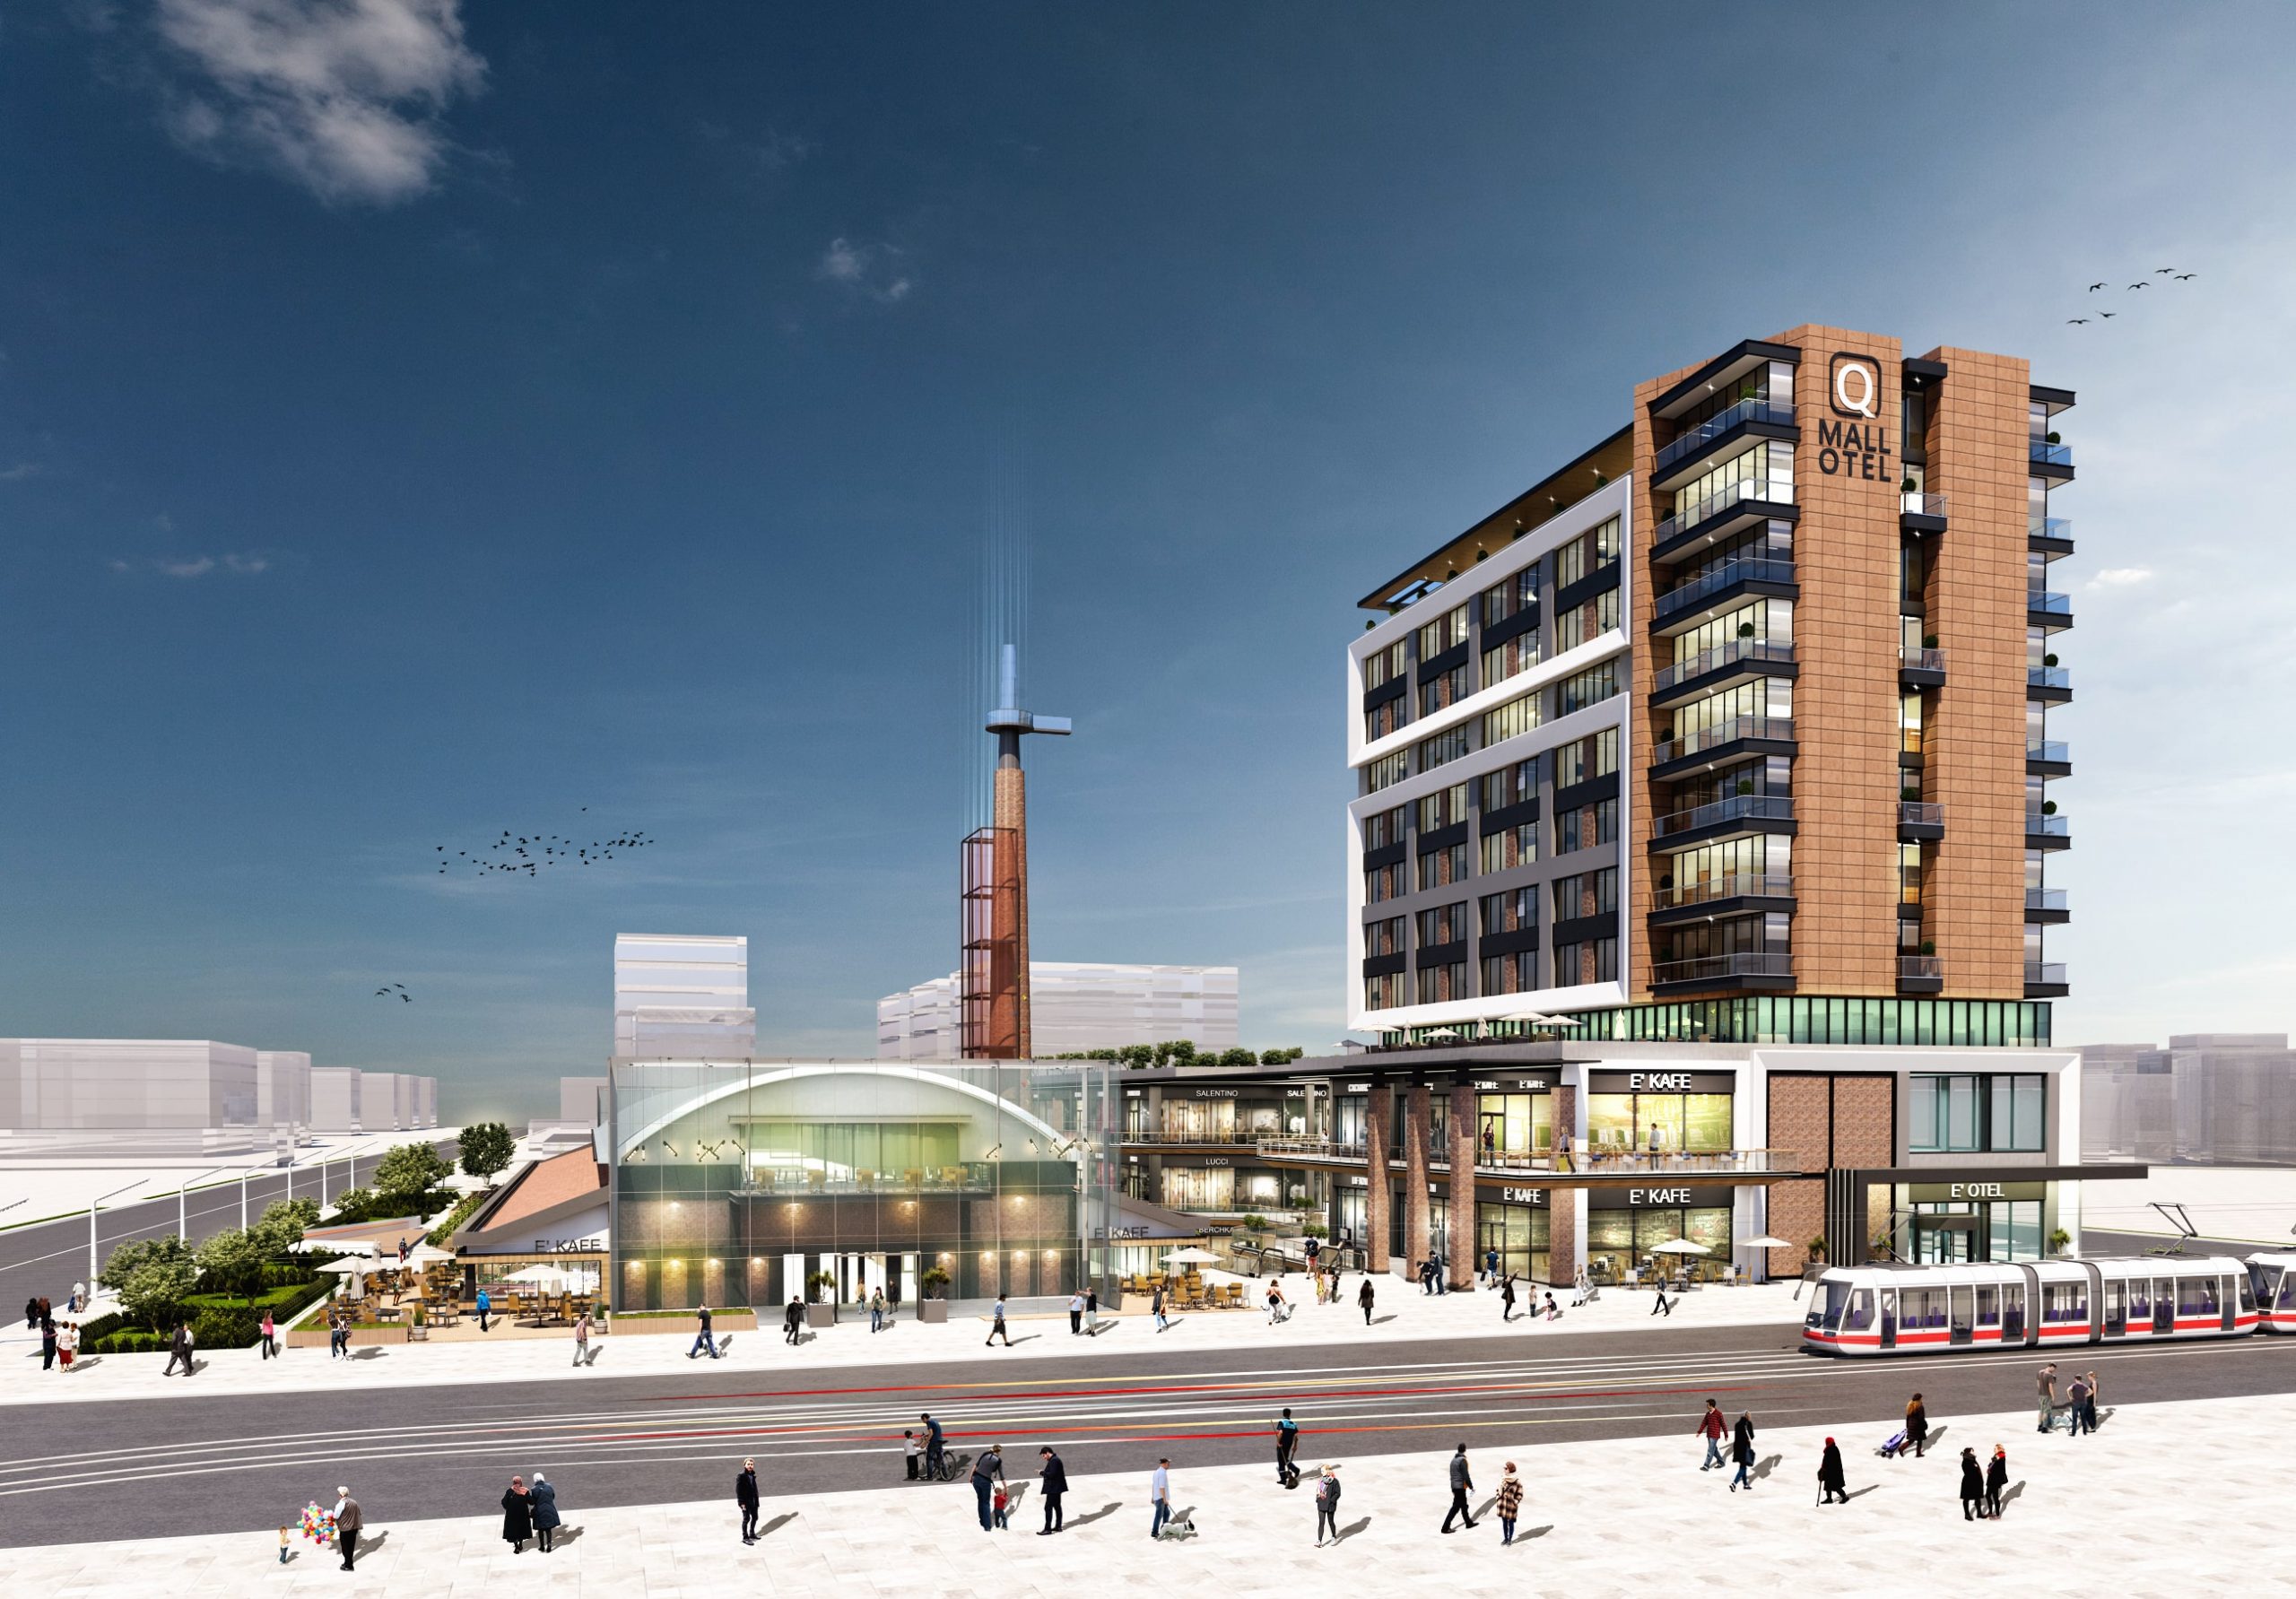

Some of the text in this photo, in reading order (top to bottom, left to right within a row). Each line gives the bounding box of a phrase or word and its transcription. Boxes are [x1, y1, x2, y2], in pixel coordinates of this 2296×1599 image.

[1837, 363, 1876, 419] Q
[1819, 419, 1891, 454] MALL
[1819, 448, 1892, 482] OTEL
[1648, 1073, 1692, 1089] KAFE
[1515, 1187, 1542, 1204] KAFE
[1648, 1188, 1691, 1204] KAFE
[1967, 1183, 2005, 1197] OTEL
[556, 1238, 602, 1252] KAFE
